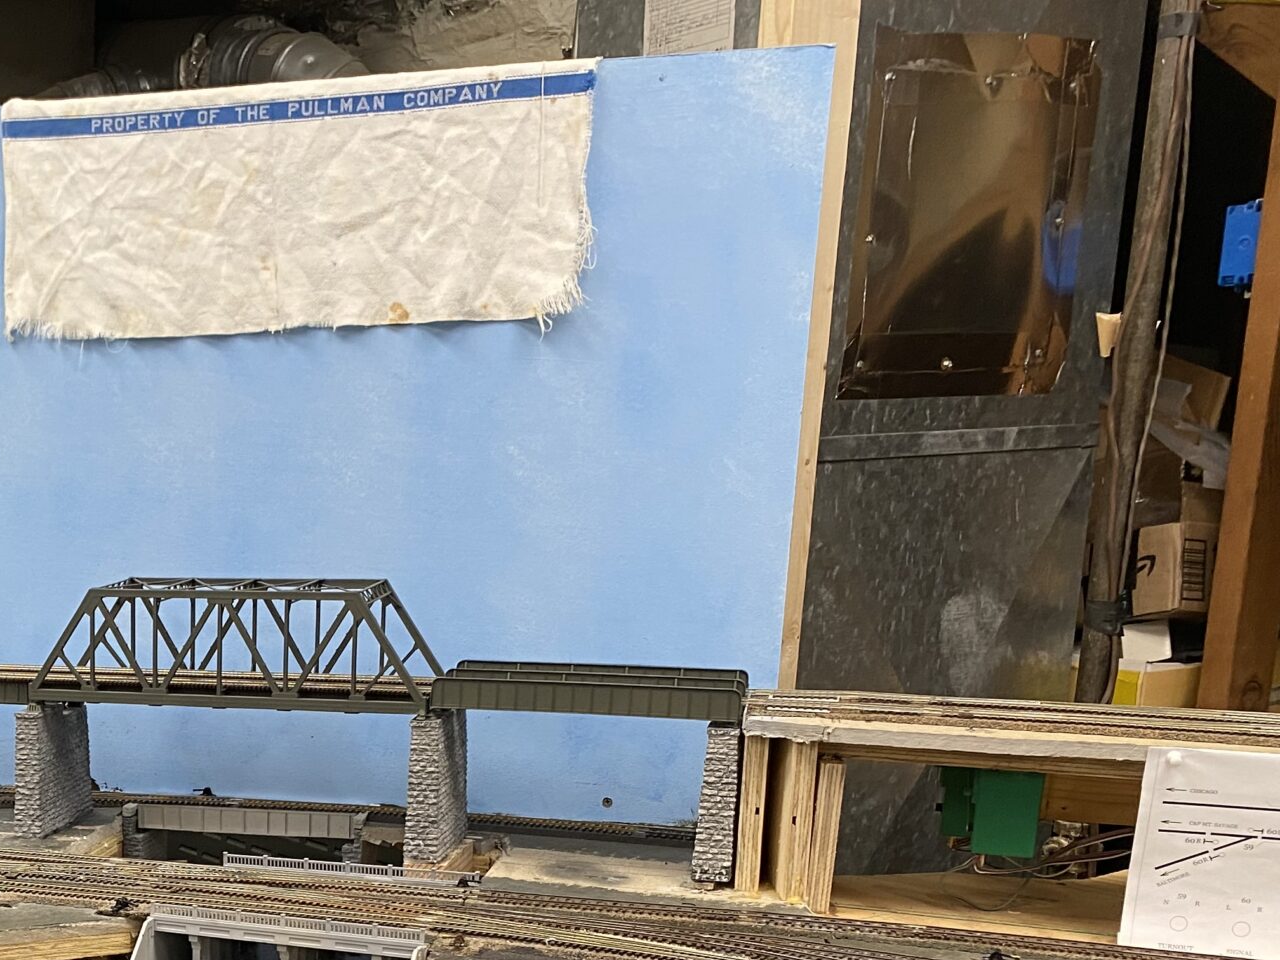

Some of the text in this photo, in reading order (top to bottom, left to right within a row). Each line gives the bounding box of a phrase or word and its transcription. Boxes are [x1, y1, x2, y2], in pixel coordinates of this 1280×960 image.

[91, 82, 503, 132] PROPERTY OF THE PULLMAN COMPANY
[1158, 943, 1194, 951] TURNOUT
[1226, 949, 1254, 957] SIGNAL
